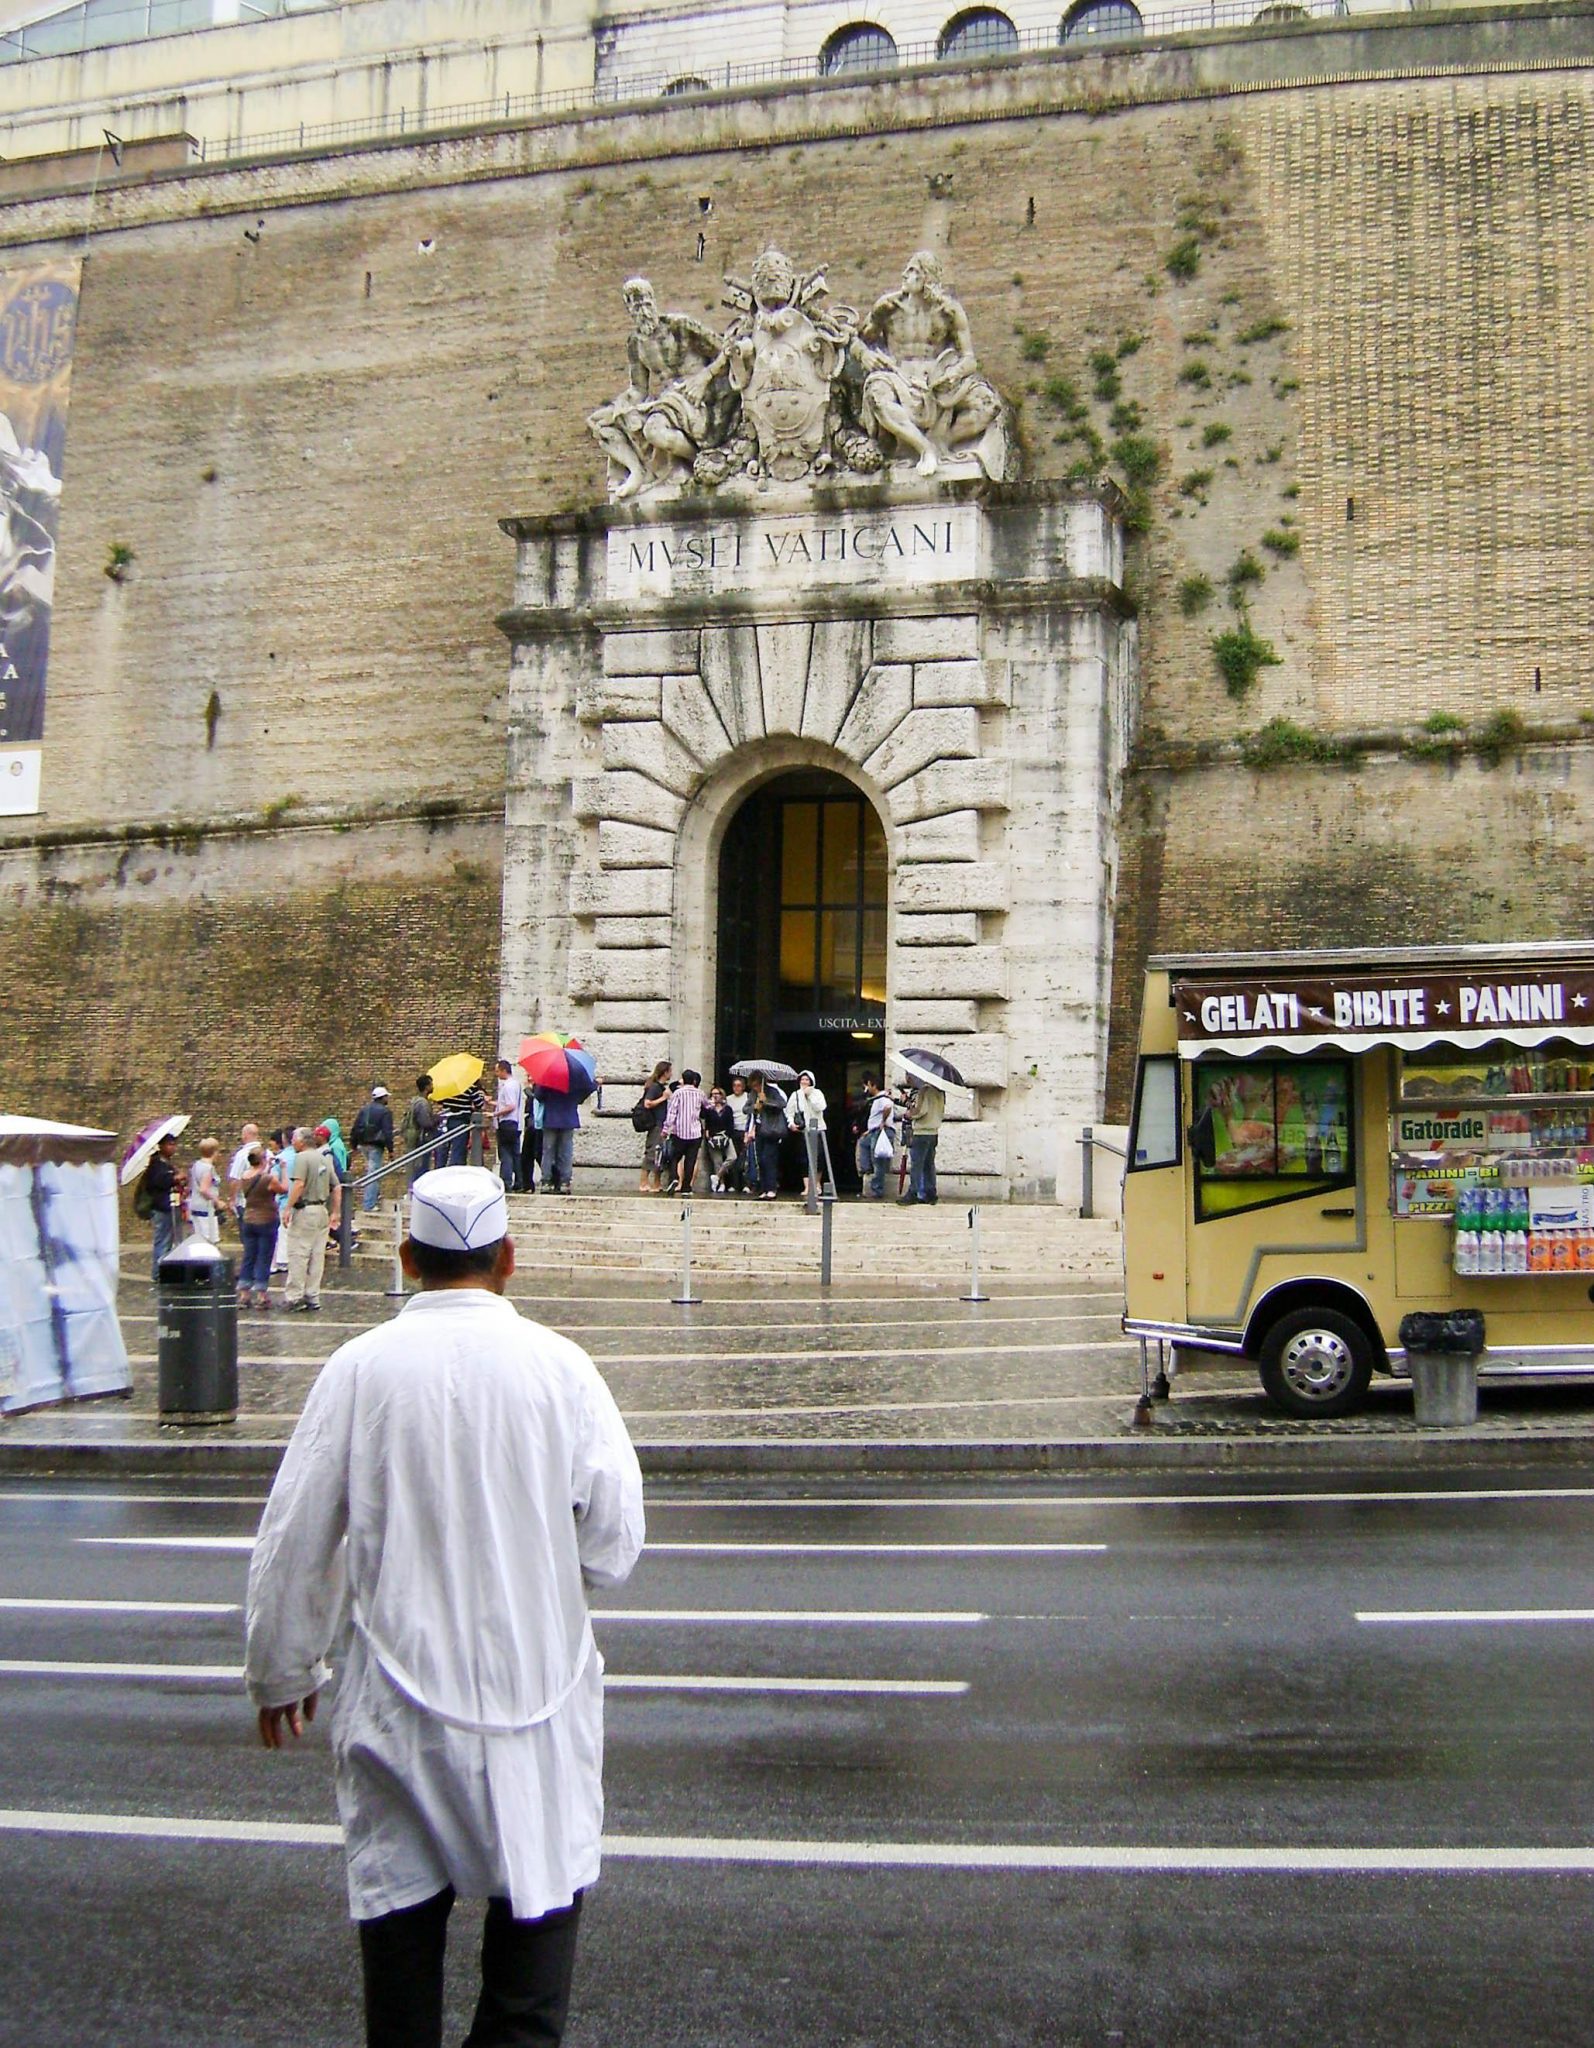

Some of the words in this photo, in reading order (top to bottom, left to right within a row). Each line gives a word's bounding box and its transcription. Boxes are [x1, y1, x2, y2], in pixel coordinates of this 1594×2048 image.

[628, 535, 742, 573] MVSEI
[765, 521, 952, 565] VATICANI
[819, 1018, 859, 1029] USCITA
[1201, 993, 1300, 1033] GELATI
[1333, 988, 1426, 1028] BIBITE
[1459, 984, 1565, 1024] PANINI
[1401, 1117, 1484, 1141] Gatorade
